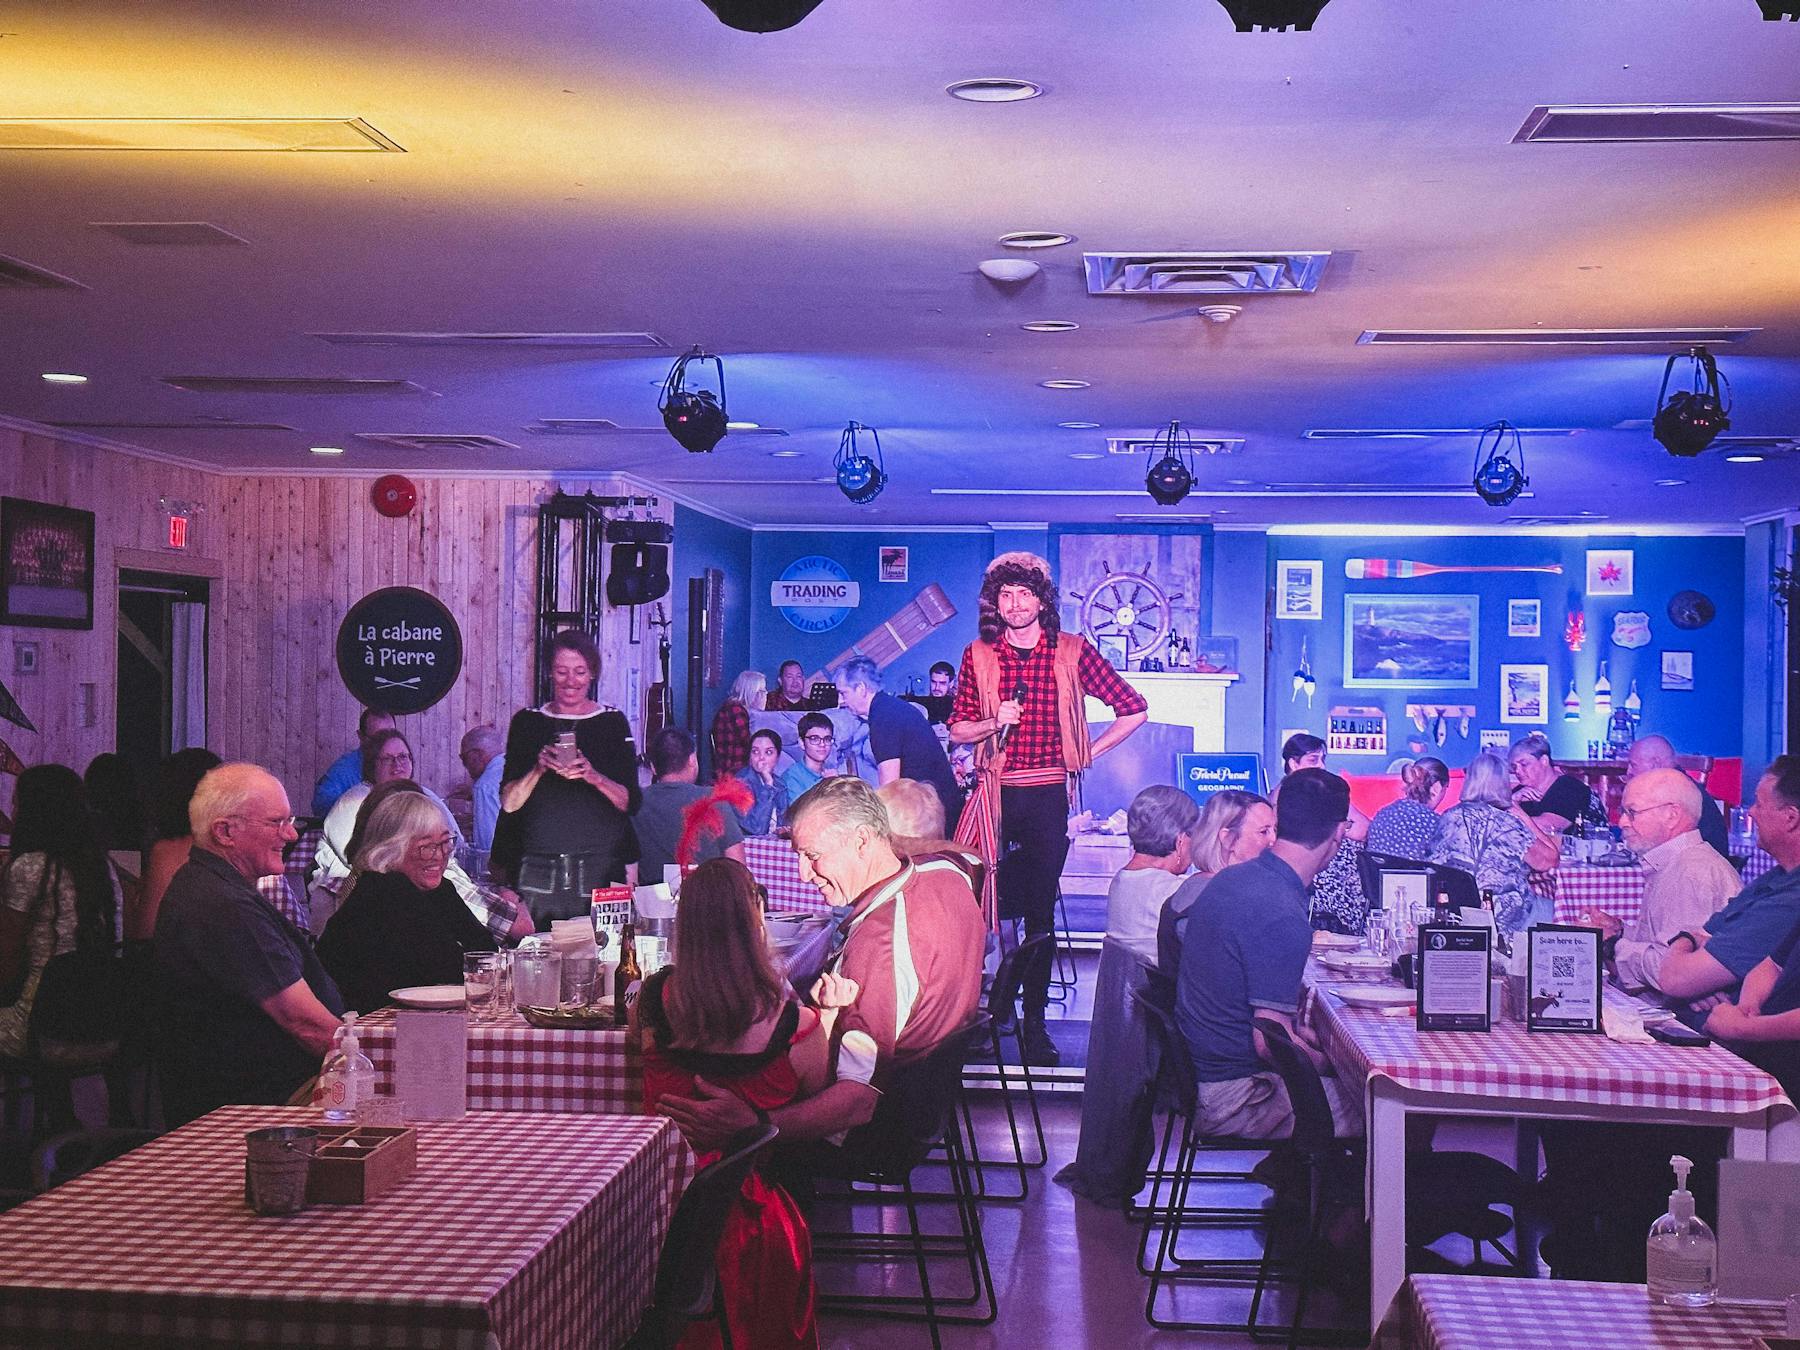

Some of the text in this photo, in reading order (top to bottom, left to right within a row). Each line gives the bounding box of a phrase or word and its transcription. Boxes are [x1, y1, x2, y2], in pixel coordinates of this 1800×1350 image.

[794, 559, 840, 576] ARCTIC
[782, 585, 847, 598] TRADING
[358, 620, 442, 641] La cabane
[790, 612, 844, 631] CIRCLE
[364, 645, 435, 667] à Pierre
[1539, 936, 1556, 945] Scan
[1557, 936, 1573, 945] here
